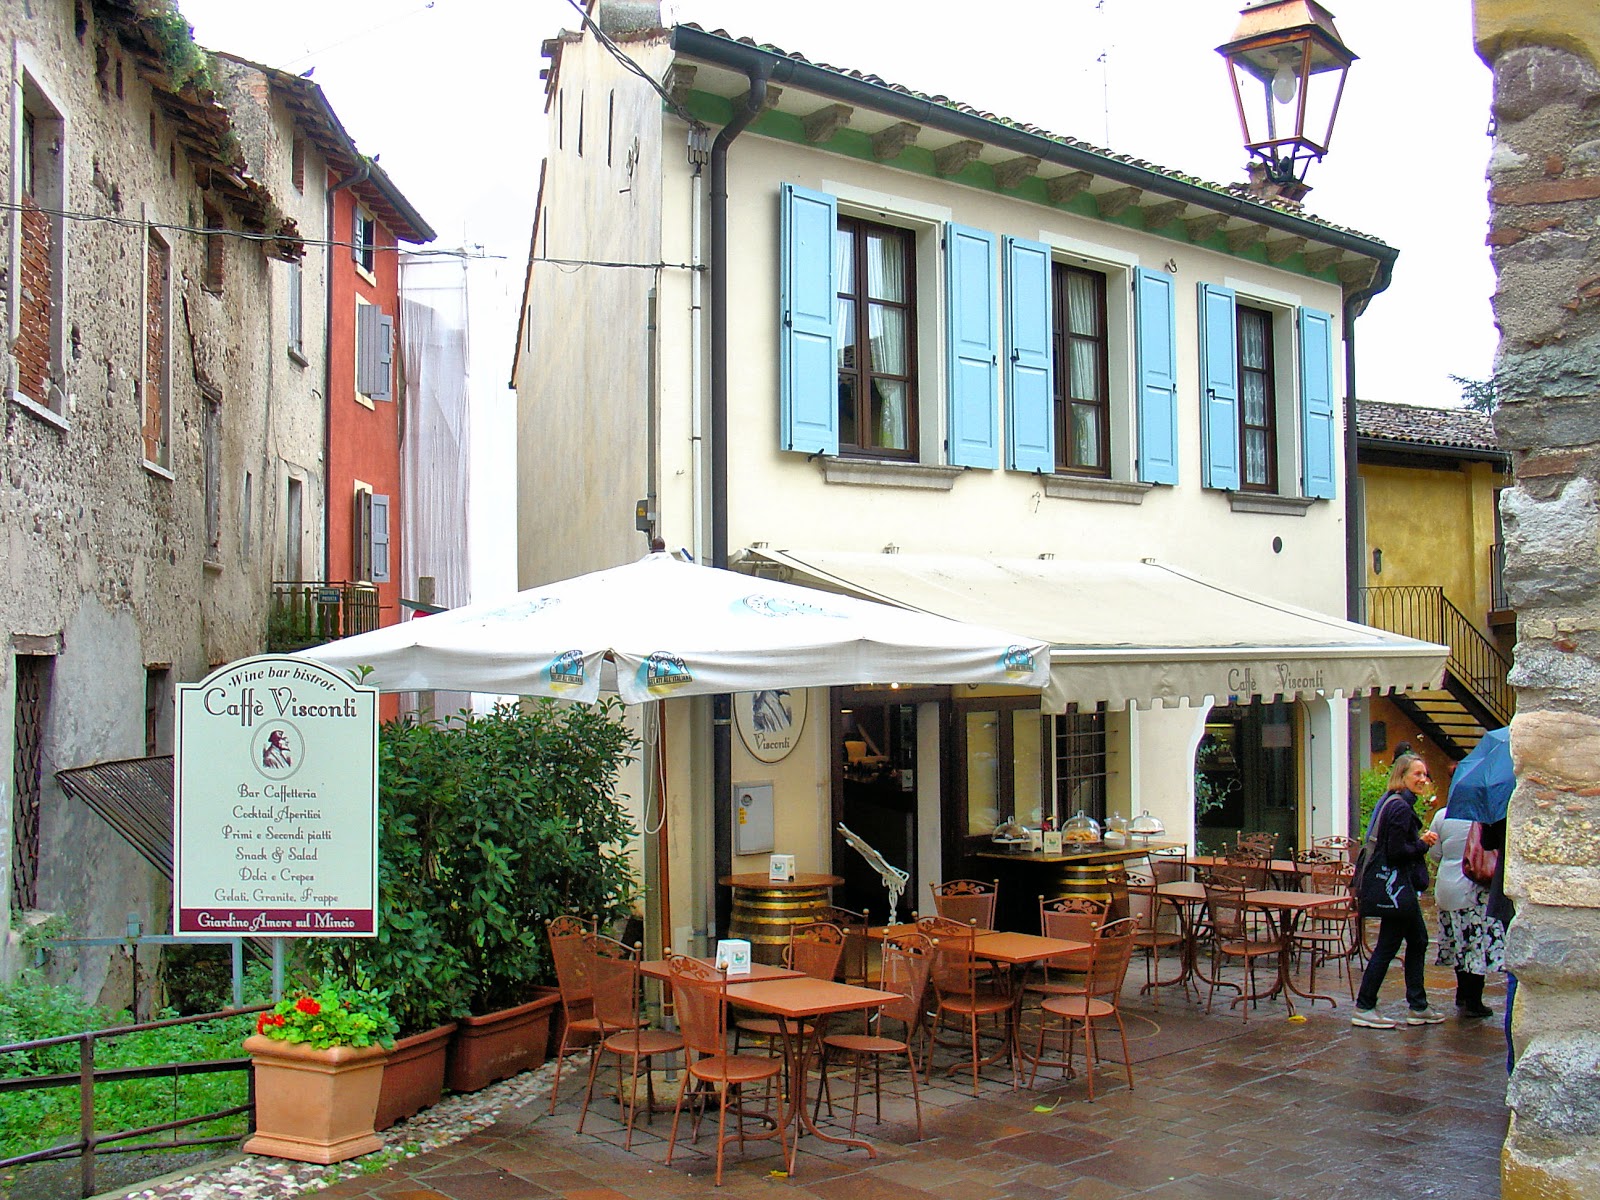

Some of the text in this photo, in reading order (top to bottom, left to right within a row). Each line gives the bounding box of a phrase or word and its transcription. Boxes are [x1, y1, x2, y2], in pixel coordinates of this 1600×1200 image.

[231, 667, 335, 691] Wine bar bistrot
[1228, 663, 1324, 698] Caffè Visconti
[203, 686, 357, 726] Caffè Visconti
[753, 732, 790, 749] Visconti
[237, 783, 317, 802] Bar Caffetteria
[232, 805, 321, 823] Cocktail Aperitivi
[221, 824, 252, 840] Primi
[265, 826, 304, 840] Secondi
[307, 830, 332, 844] piatti
[236, 847, 318, 864] Snack & Salad
[238, 866, 267, 881] Dolci
[280, 868, 314, 885] Crepes
[214, 887, 339, 907] Gelati, Granite, Frappe
[197, 912, 355, 932] Giardino Amore sul Mincio
